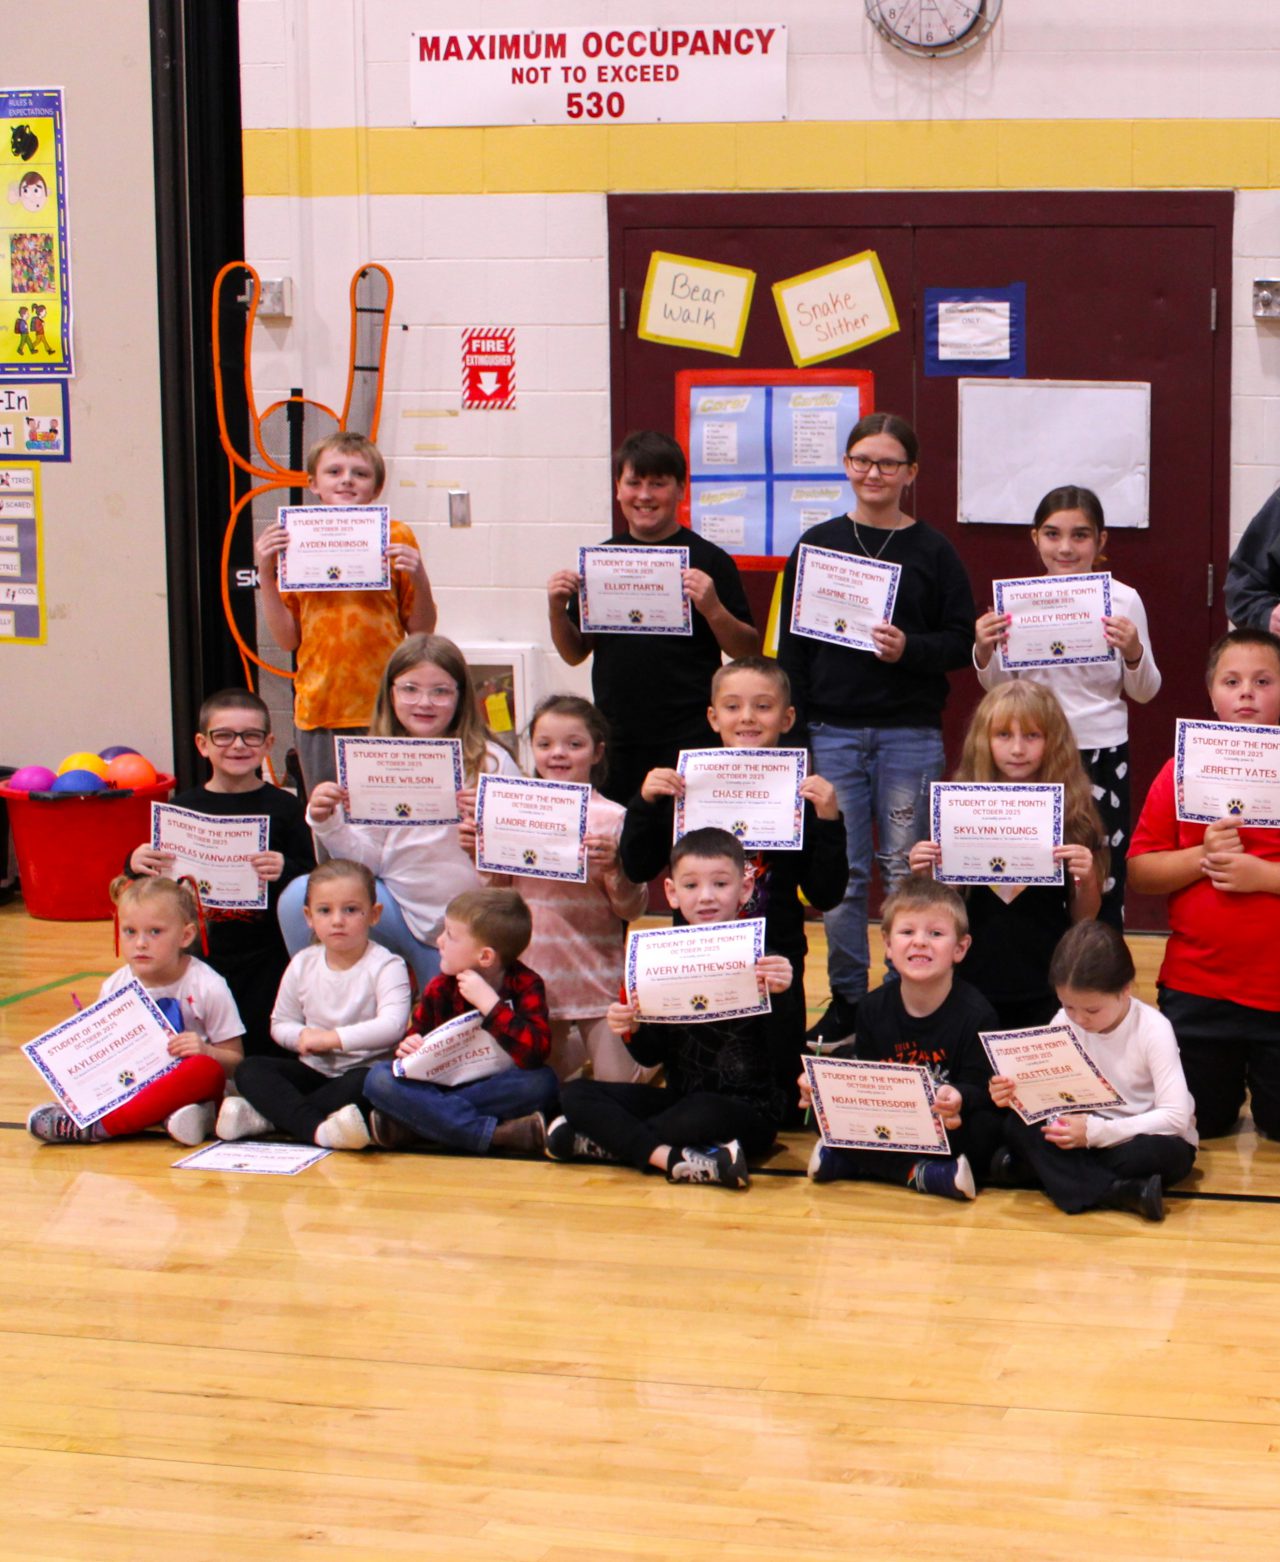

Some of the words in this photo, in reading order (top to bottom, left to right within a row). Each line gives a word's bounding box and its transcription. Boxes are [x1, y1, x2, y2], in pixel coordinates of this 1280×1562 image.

[888, 8, 896, 20] 8
[963, 8, 970, 18] 4
[904, 25, 911, 35] 7
[926, 31, 934, 42] 6
[419, 33, 567, 61] MAXIMUM
[583, 28, 776, 57] OCCUPANCY
[511, 66, 550, 84] NOT
[561, 66, 586, 83] TO
[597, 64, 680, 82] EXCEED
[567, 92, 626, 118] 530
[9, 108, 54, 117] EXPECTATIONS
[671, 272, 726, 304] Bear
[796, 292, 857, 328] Snake
[815, 313, 870, 342] Slither
[471, 339, 506, 352] FIRE
[466, 354, 511, 366] EXTINGUISHER
[604, 583, 630, 591] ELLIOT
[817, 588, 846, 600] JASMINE
[848, 594, 868, 605] TITUS
[1056, 612, 1089, 621] ROMEYN
[1193, 737, 1230, 747] STUDENT
[1232, 740, 1242, 748] OF
[1244, 741, 1259, 749] THE
[1201, 765, 1241, 776] JERRETT
[1244, 768, 1277, 778] YATES
[399, 776, 434, 784] WILSON
[713, 791, 743, 799] CHASE
[746, 791, 769, 799] REED
[529, 821, 566, 831] ROBERTS
[954, 826, 996, 835] SKYLYNN
[1000, 827, 1038, 835] YOUNGS
[160, 842, 197, 858] NICHOLAS
[646, 965, 678, 976] AVERY
[682, 961, 746, 974] MATHEWSON
[68, 1046, 108, 1076] KAYLEIGH
[111, 1025, 144, 1052] FRAISER
[426, 1055, 463, 1077] FORREST
[1017, 1068, 1052, 1080] COLETTE
[832, 1096, 857, 1105] NOAH
